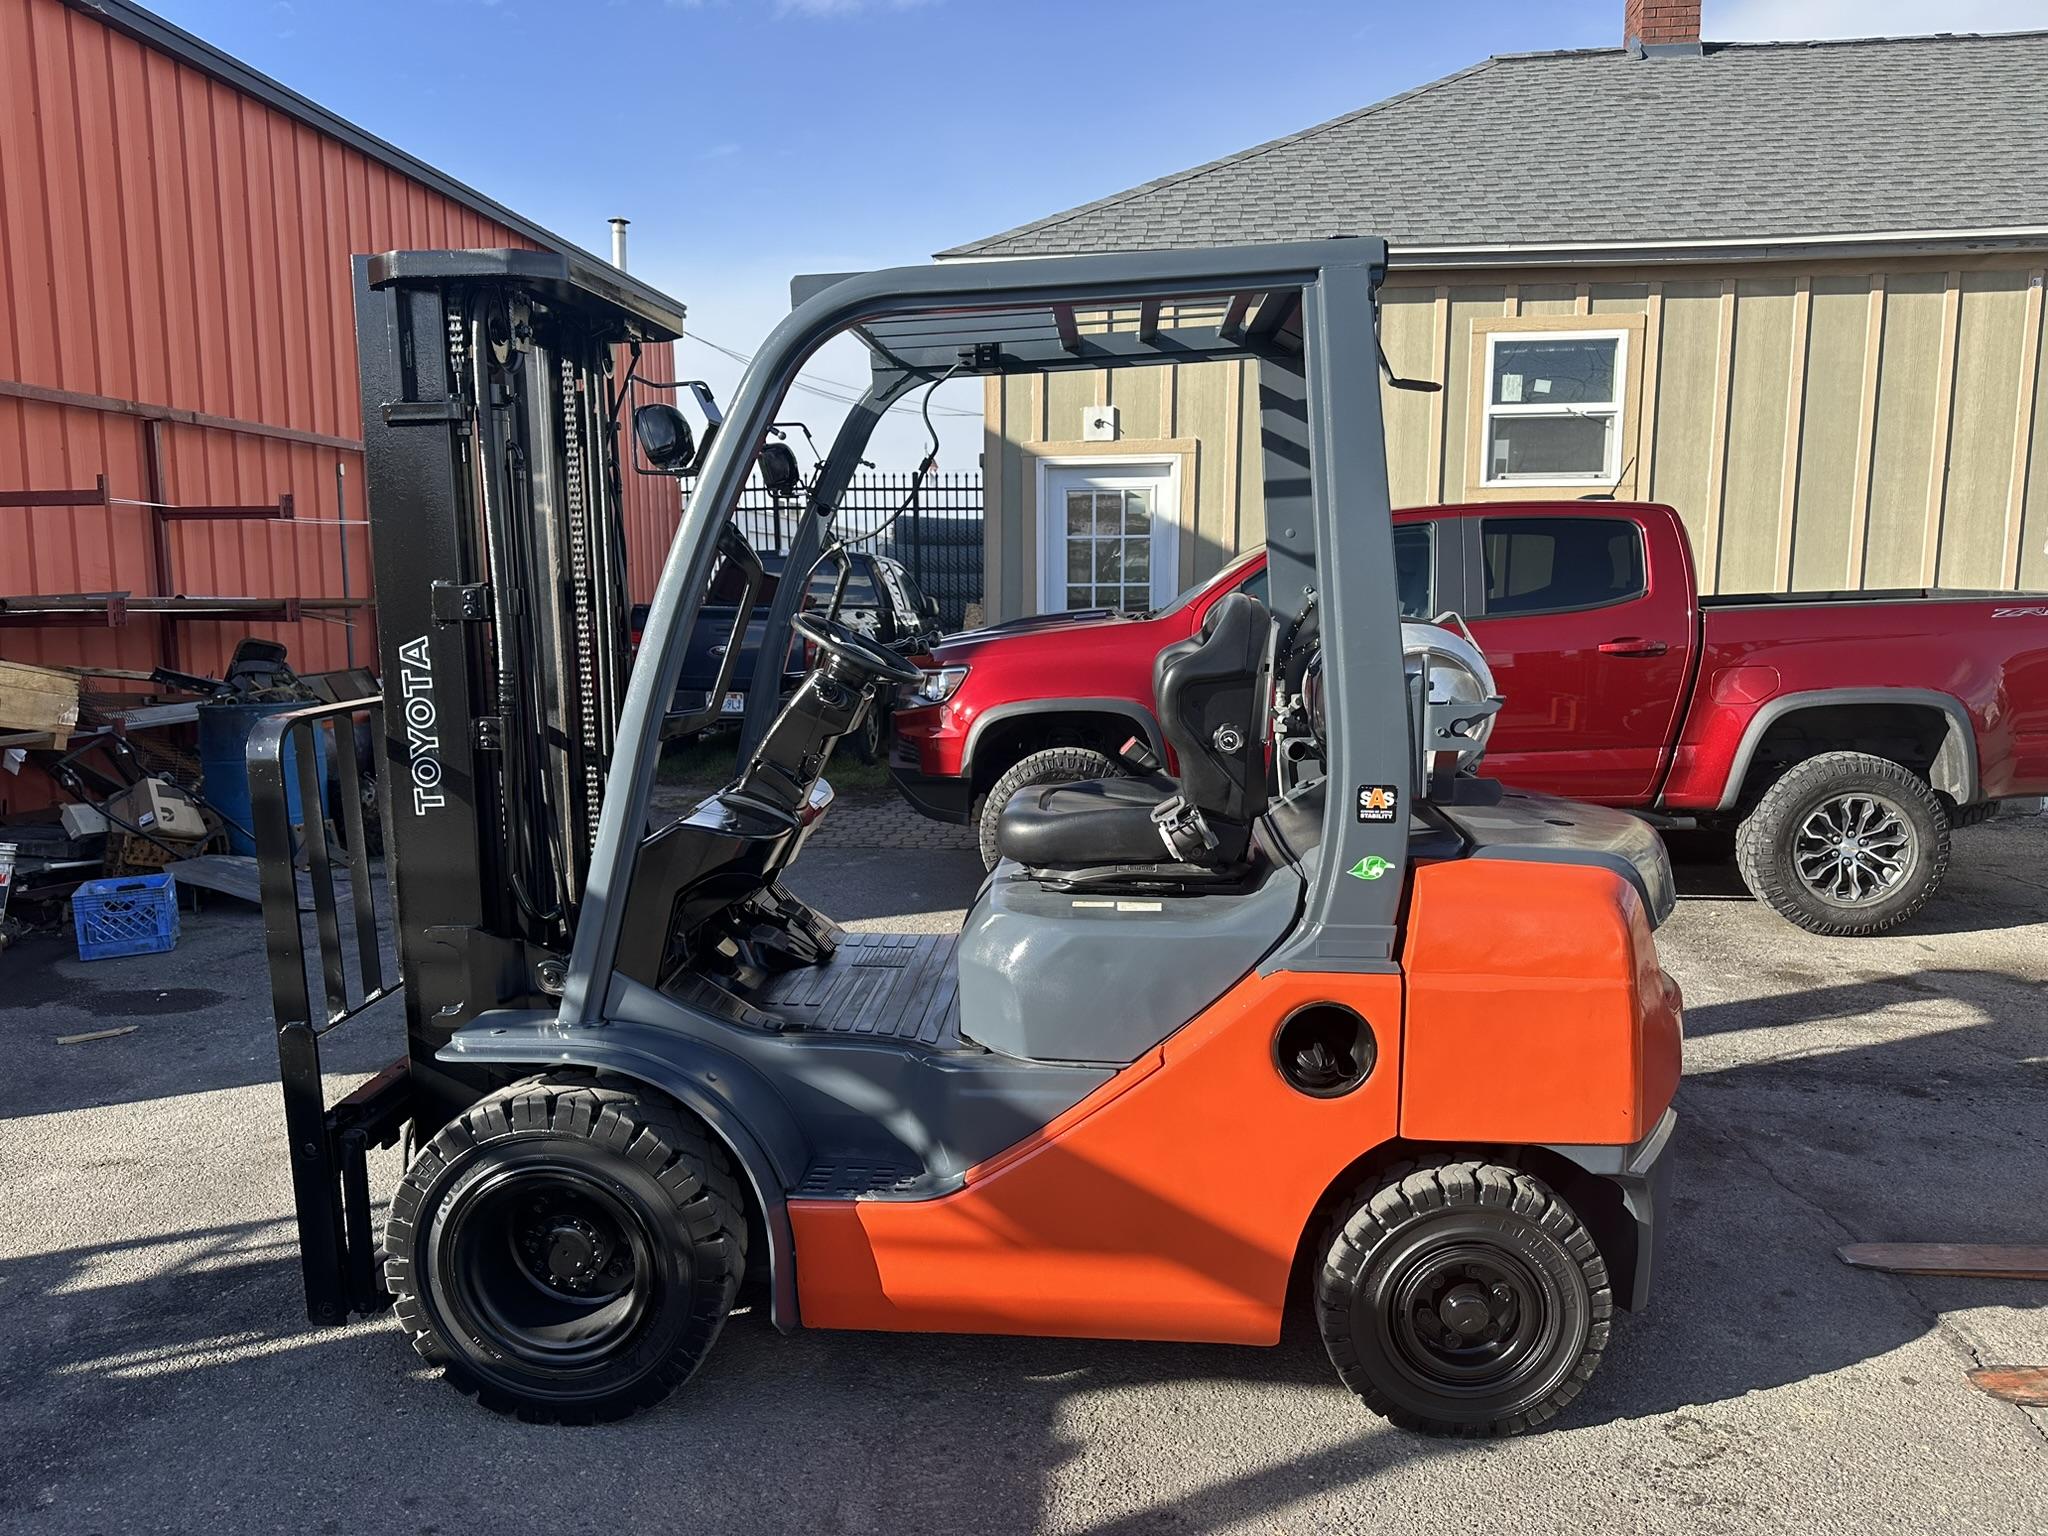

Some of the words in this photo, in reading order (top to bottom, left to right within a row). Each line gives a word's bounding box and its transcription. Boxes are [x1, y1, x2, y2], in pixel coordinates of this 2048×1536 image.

[1991, 606, 2048, 617] ZR
[399, 635, 445, 815] TOYOTA
[1360, 788, 1395, 809] SAS
